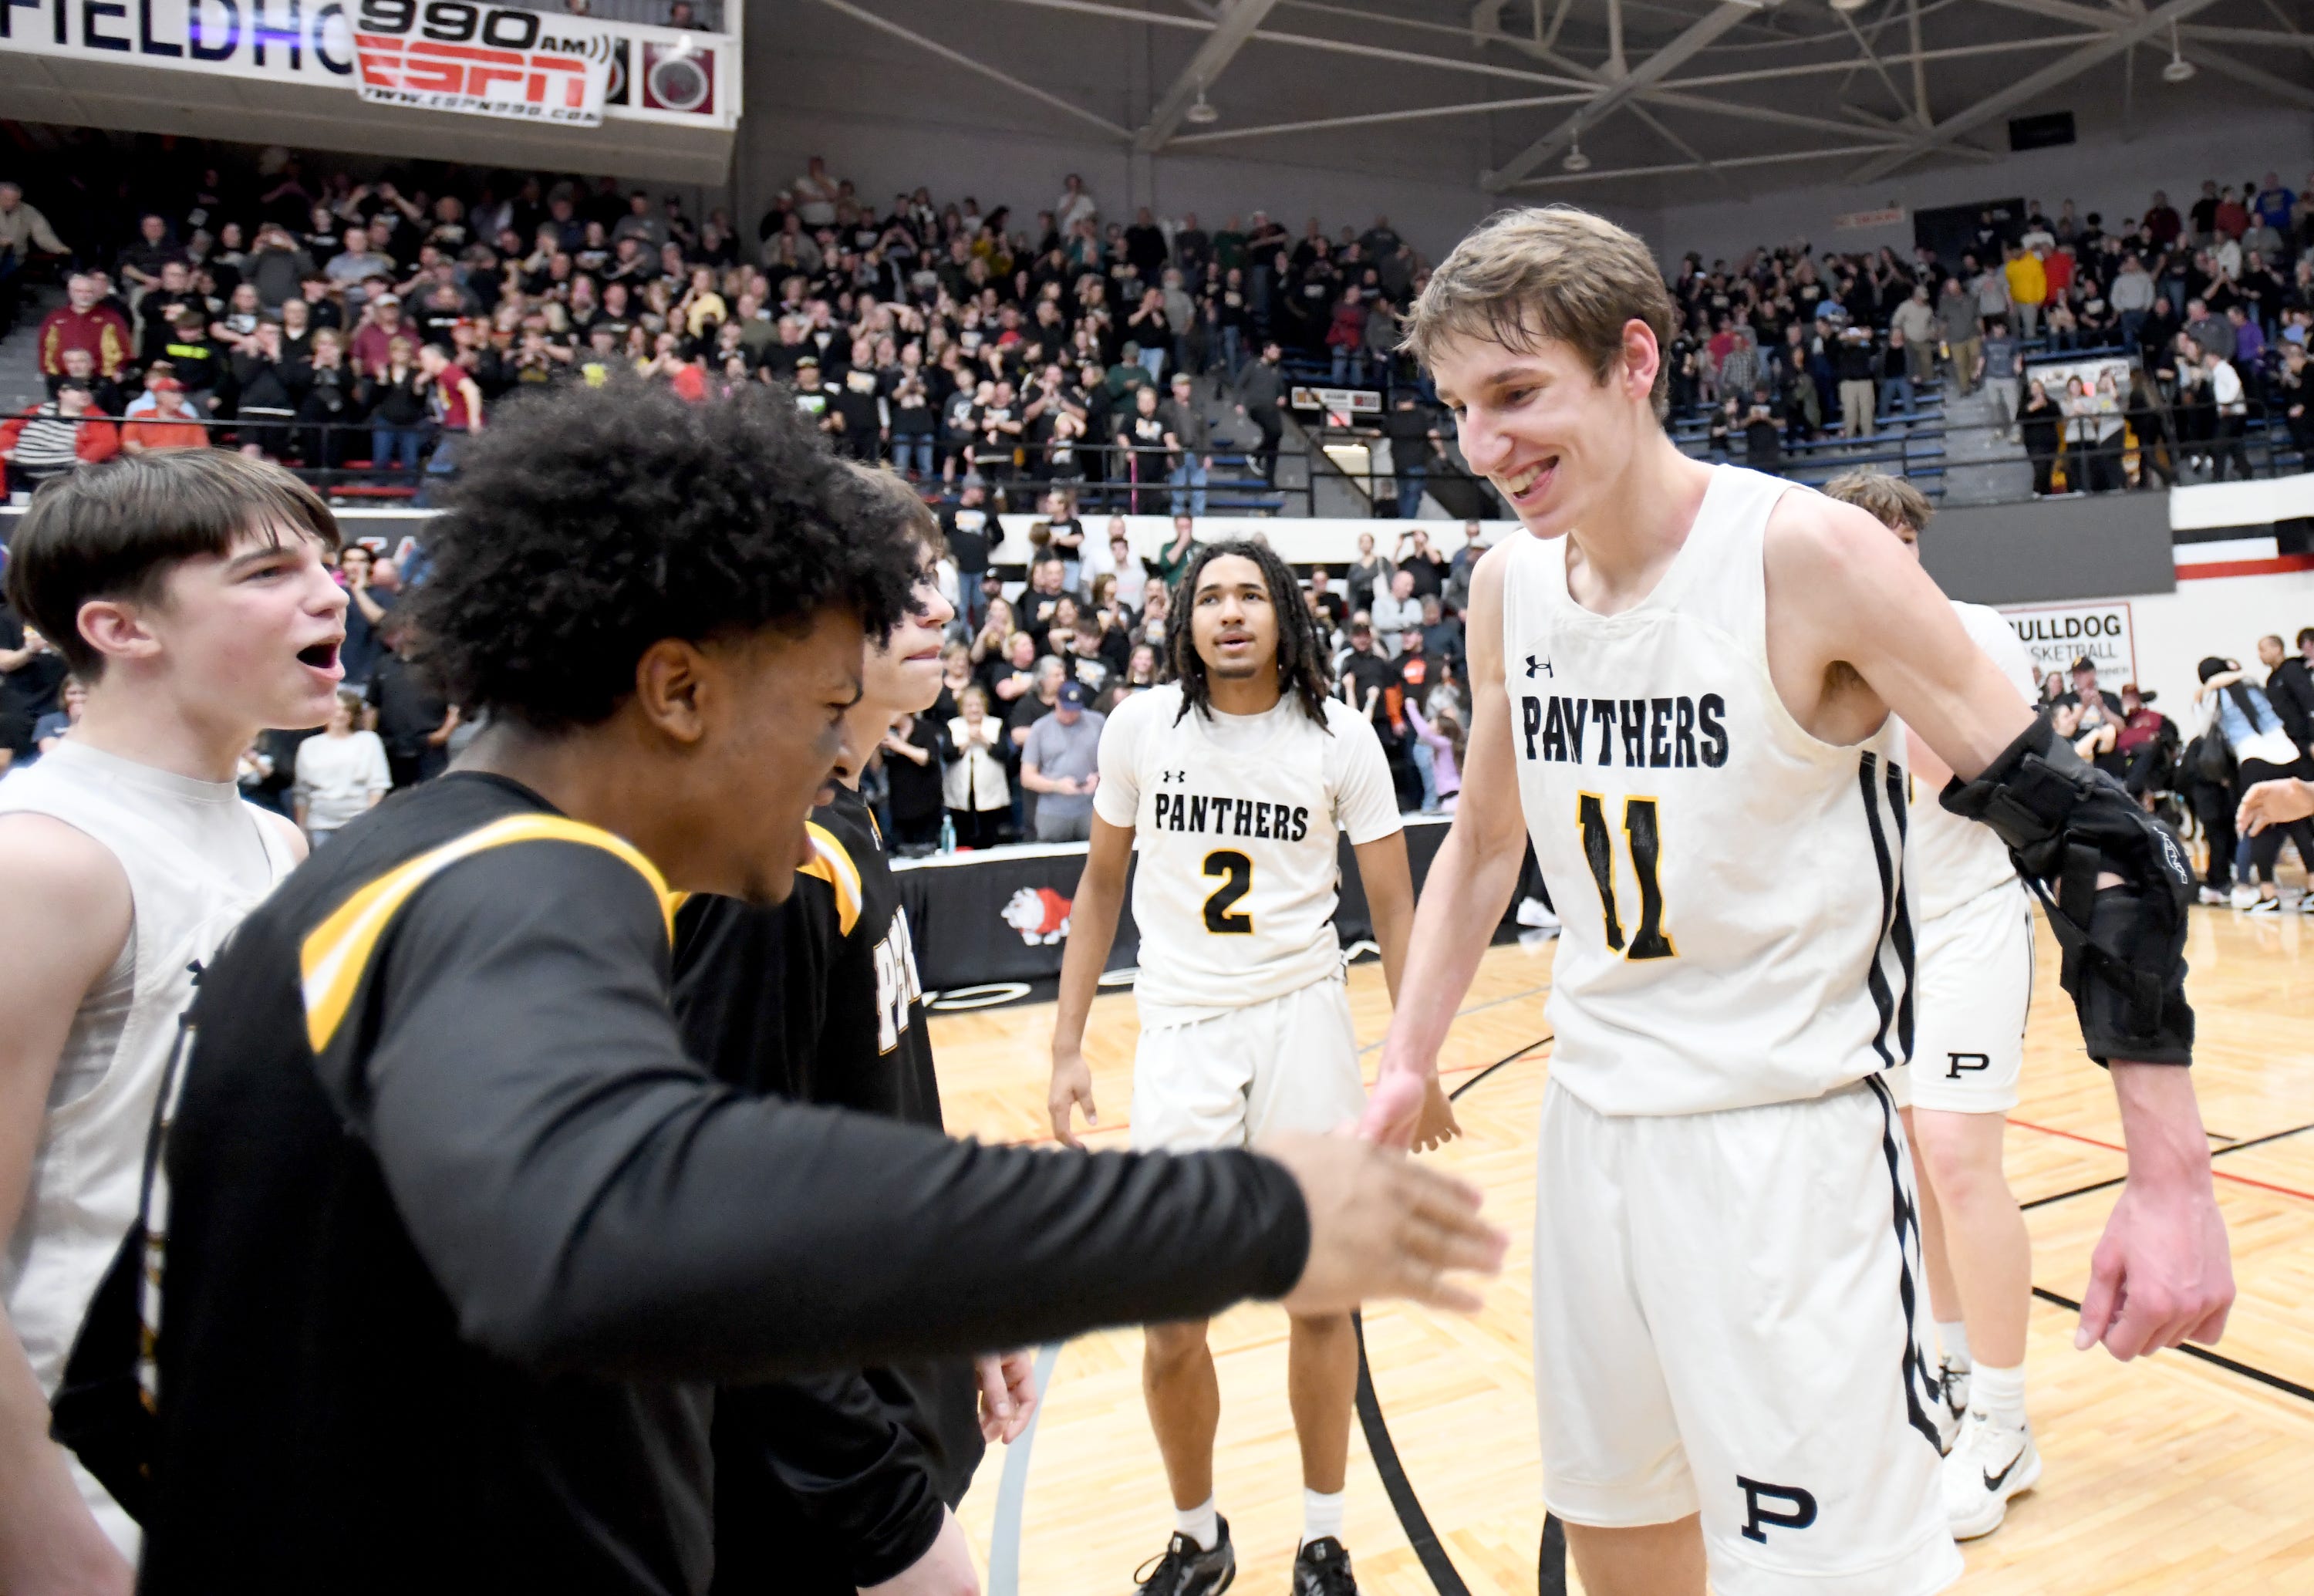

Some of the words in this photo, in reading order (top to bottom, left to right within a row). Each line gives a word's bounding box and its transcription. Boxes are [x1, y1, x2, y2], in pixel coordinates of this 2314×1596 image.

[358, 0, 540, 49] 990
[540, 35, 587, 54] AM
[355, 34, 585, 108] ESPN
[1522, 693, 1729, 768] PANTHERS
[1156, 793, 1309, 842] PANTHERS
[1202, 849, 1254, 935] 2
[1575, 789, 1680, 962] 11
[1946, 1052, 1990, 1080] P
[1736, 1474, 1818, 1544] P
